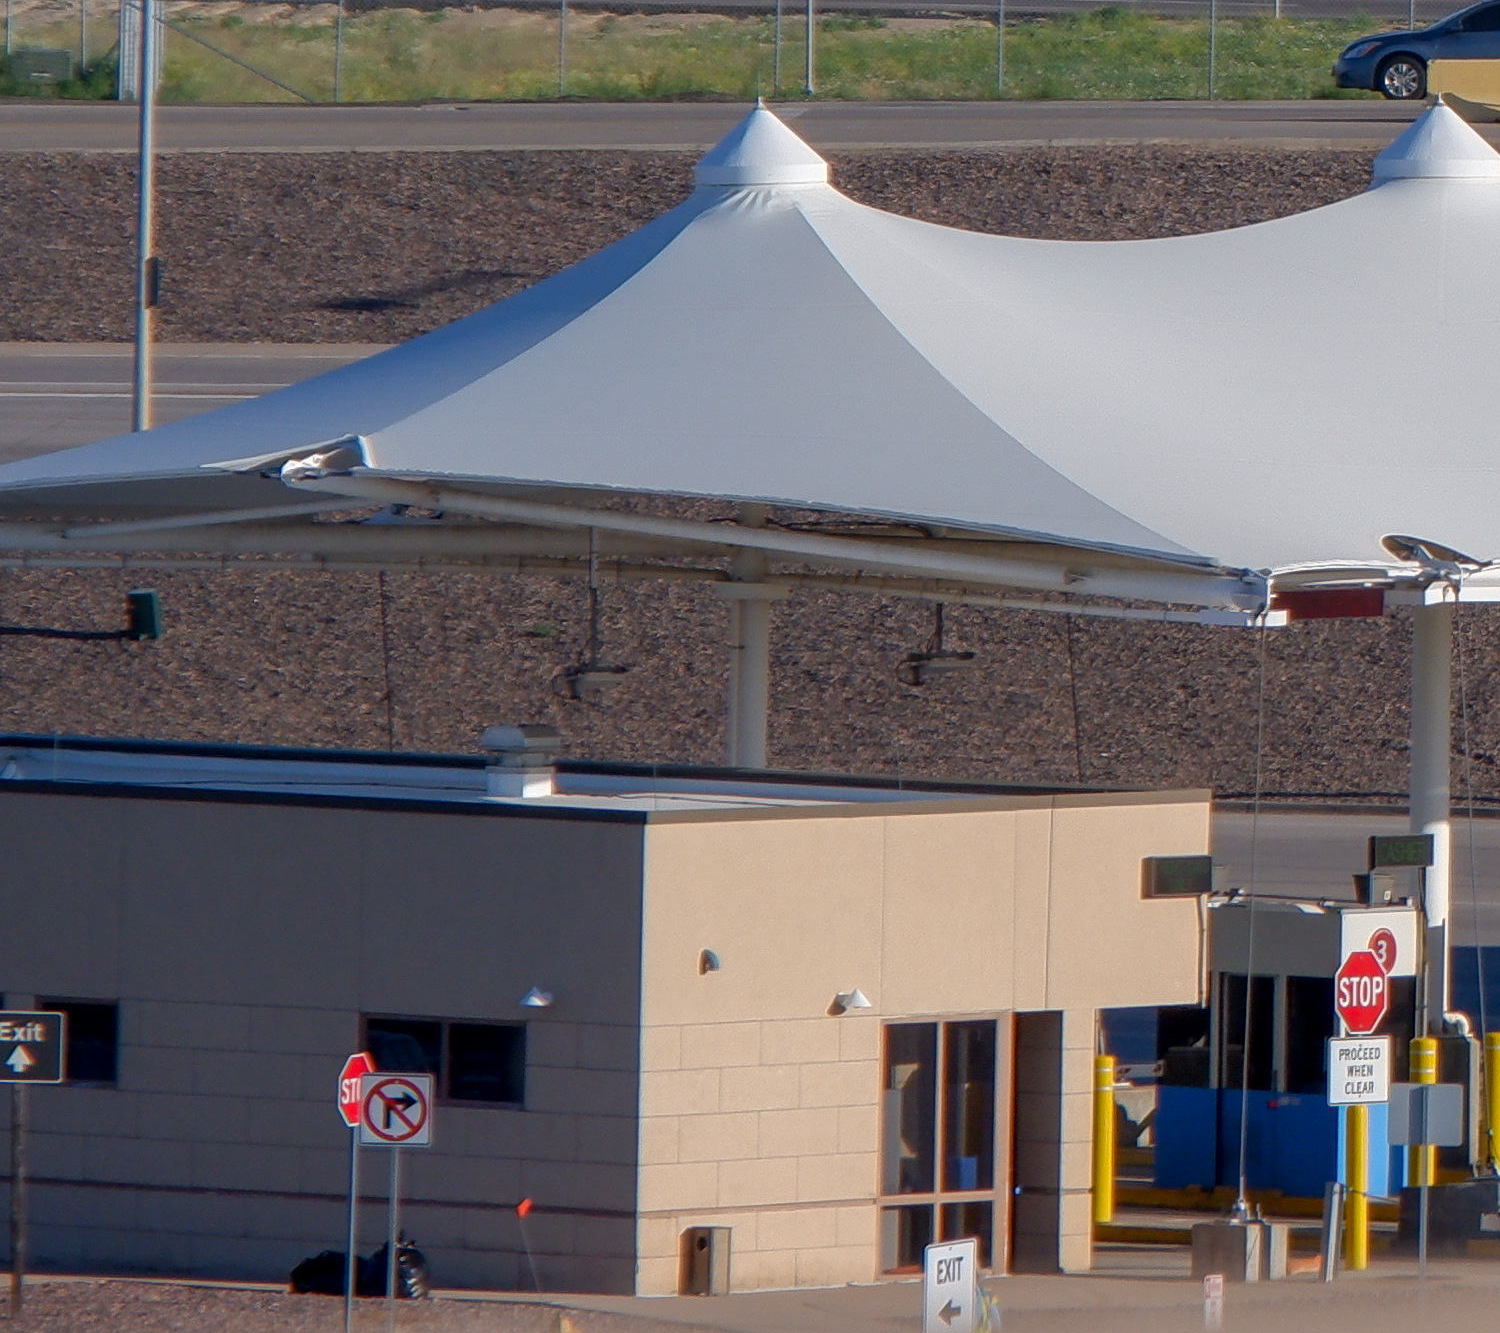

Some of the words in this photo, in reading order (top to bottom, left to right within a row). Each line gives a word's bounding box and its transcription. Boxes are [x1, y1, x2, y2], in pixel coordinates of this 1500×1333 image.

[1377, 939, 1387, 964] 3
[1339, 976, 1383, 1008] STOP
[1338, 1047, 1381, 1062] PROCEED
[1347, 1064, 1374, 1078] WHEN
[1344, 1081, 1374, 1095] CLEAR
[936, 1256, 963, 1284] EXIT
